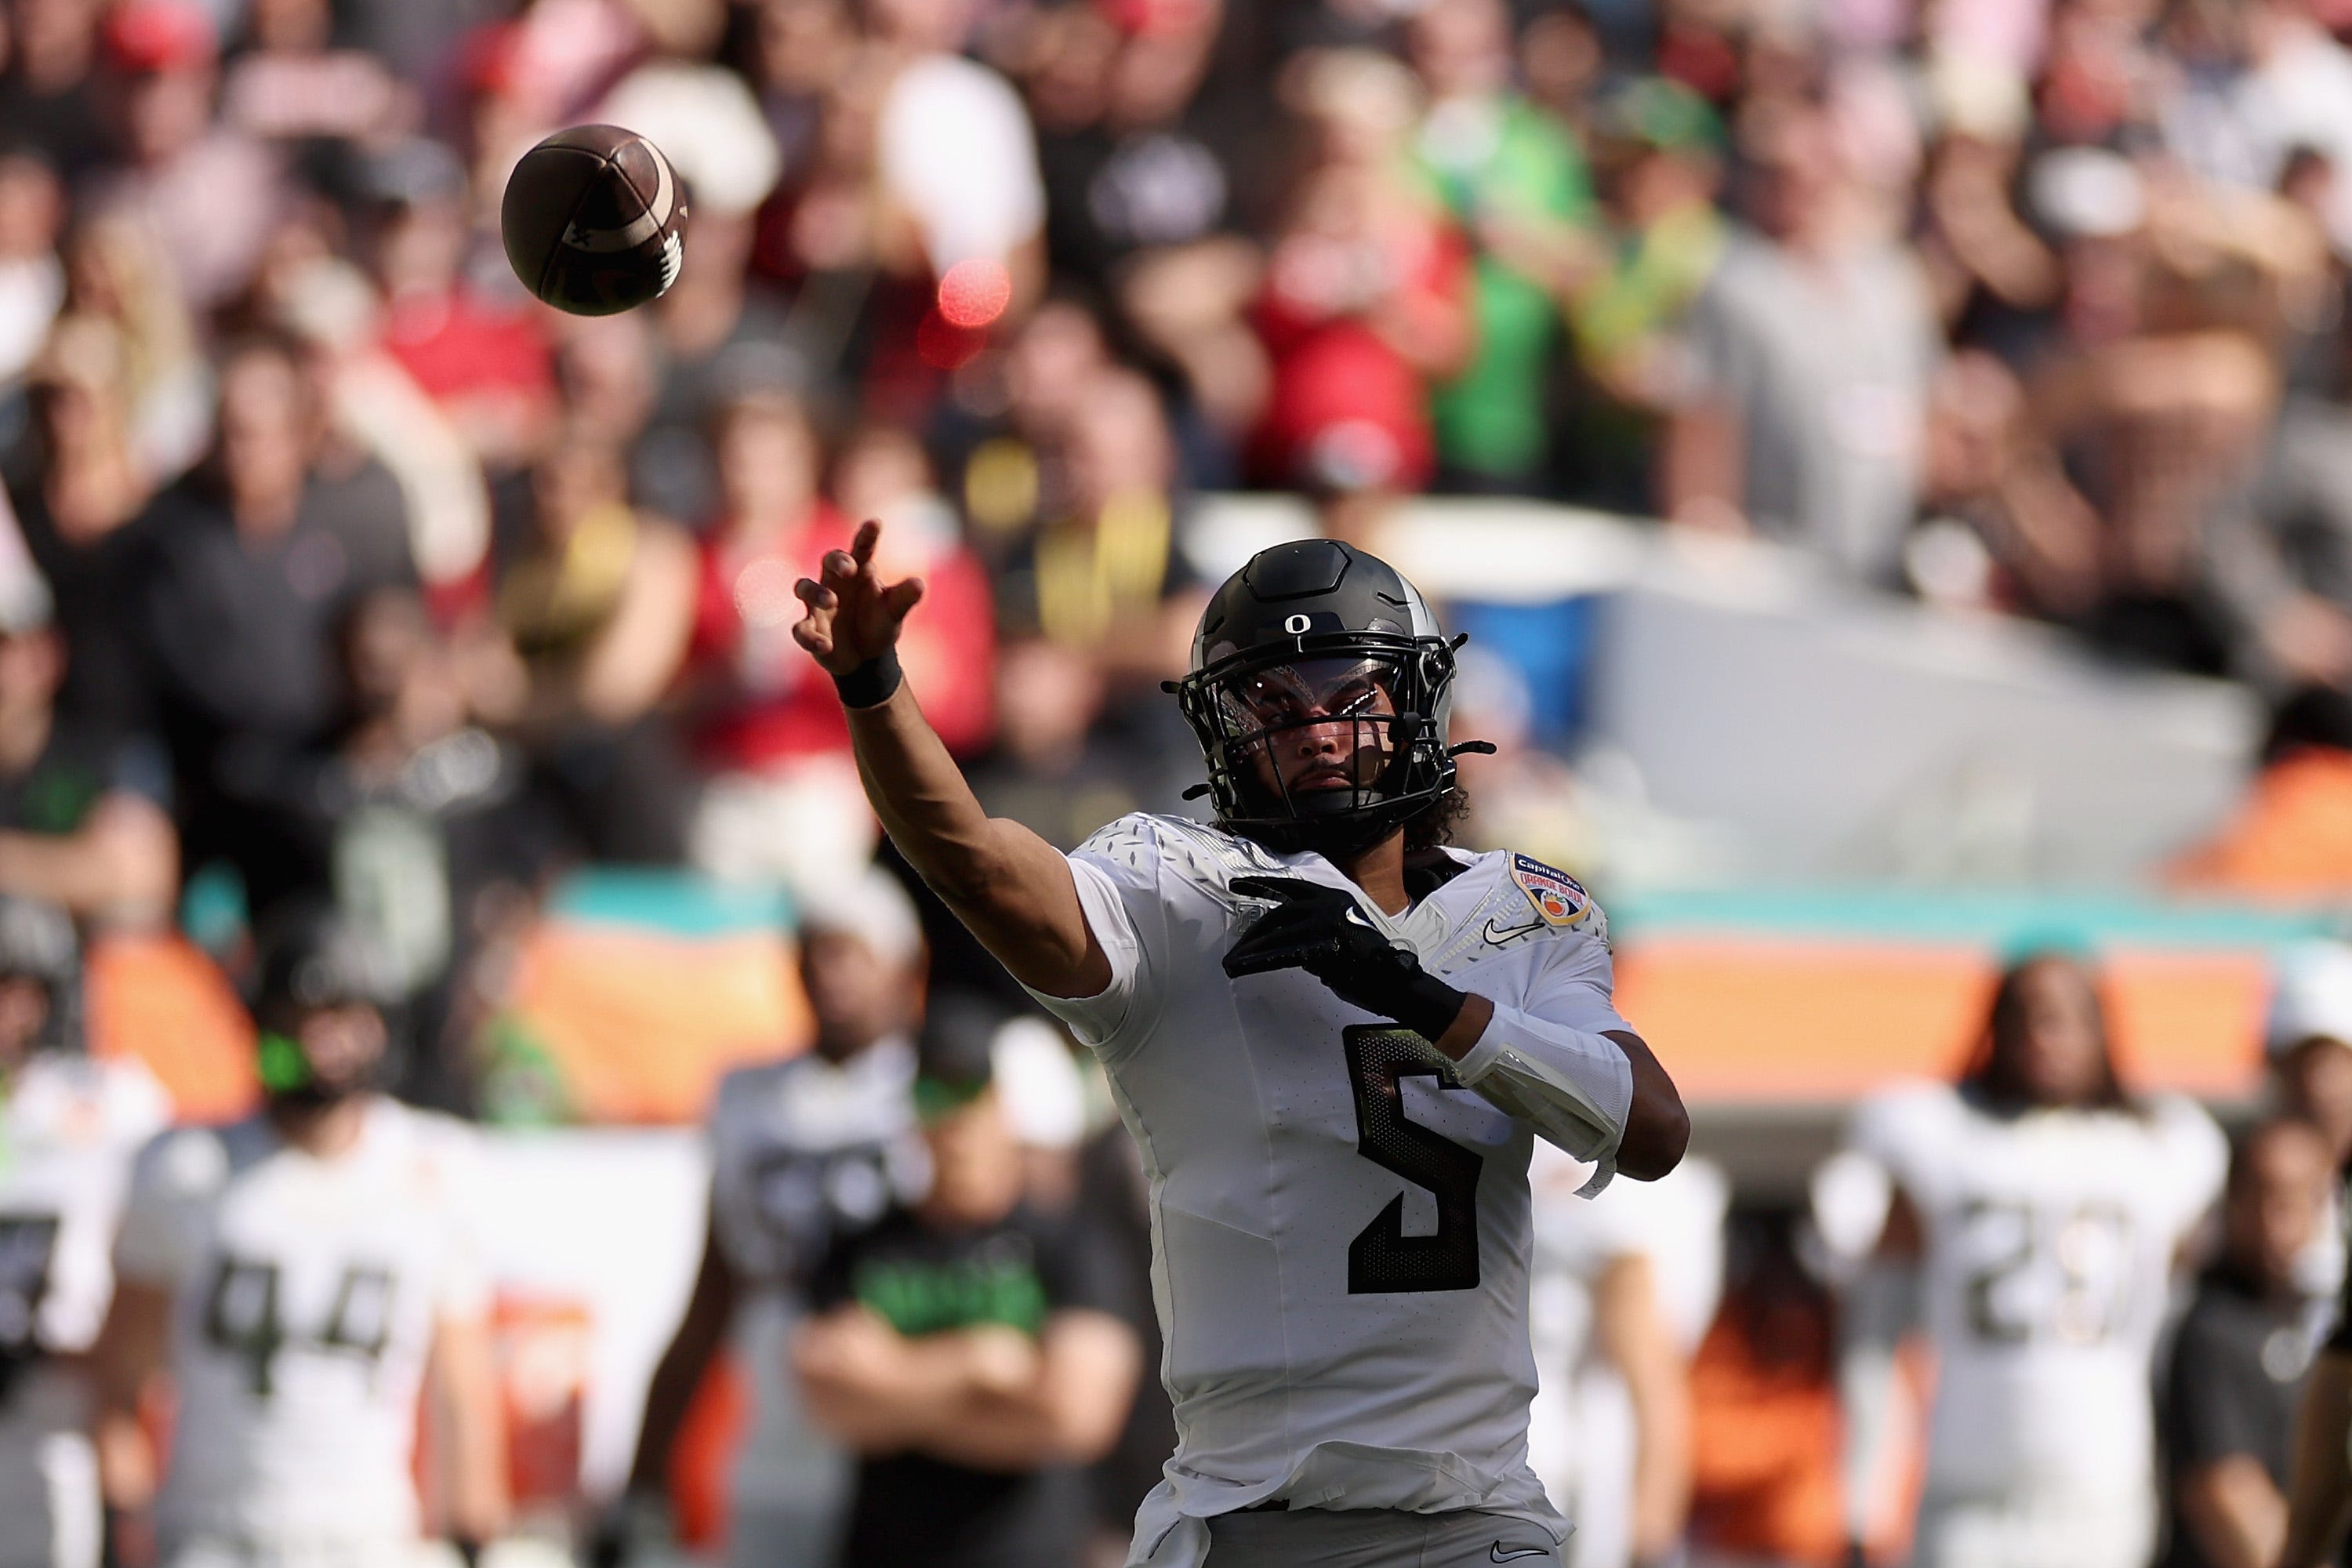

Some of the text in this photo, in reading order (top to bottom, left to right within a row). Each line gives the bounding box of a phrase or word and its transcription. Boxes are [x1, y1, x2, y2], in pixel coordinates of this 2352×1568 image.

[1285, 614, 1312, 634] O
[1520, 873, 1585, 906] ORANGE BOWL
[1342, 1021, 1483, 1294] 5
[201, 1248, 395, 1400] 44
